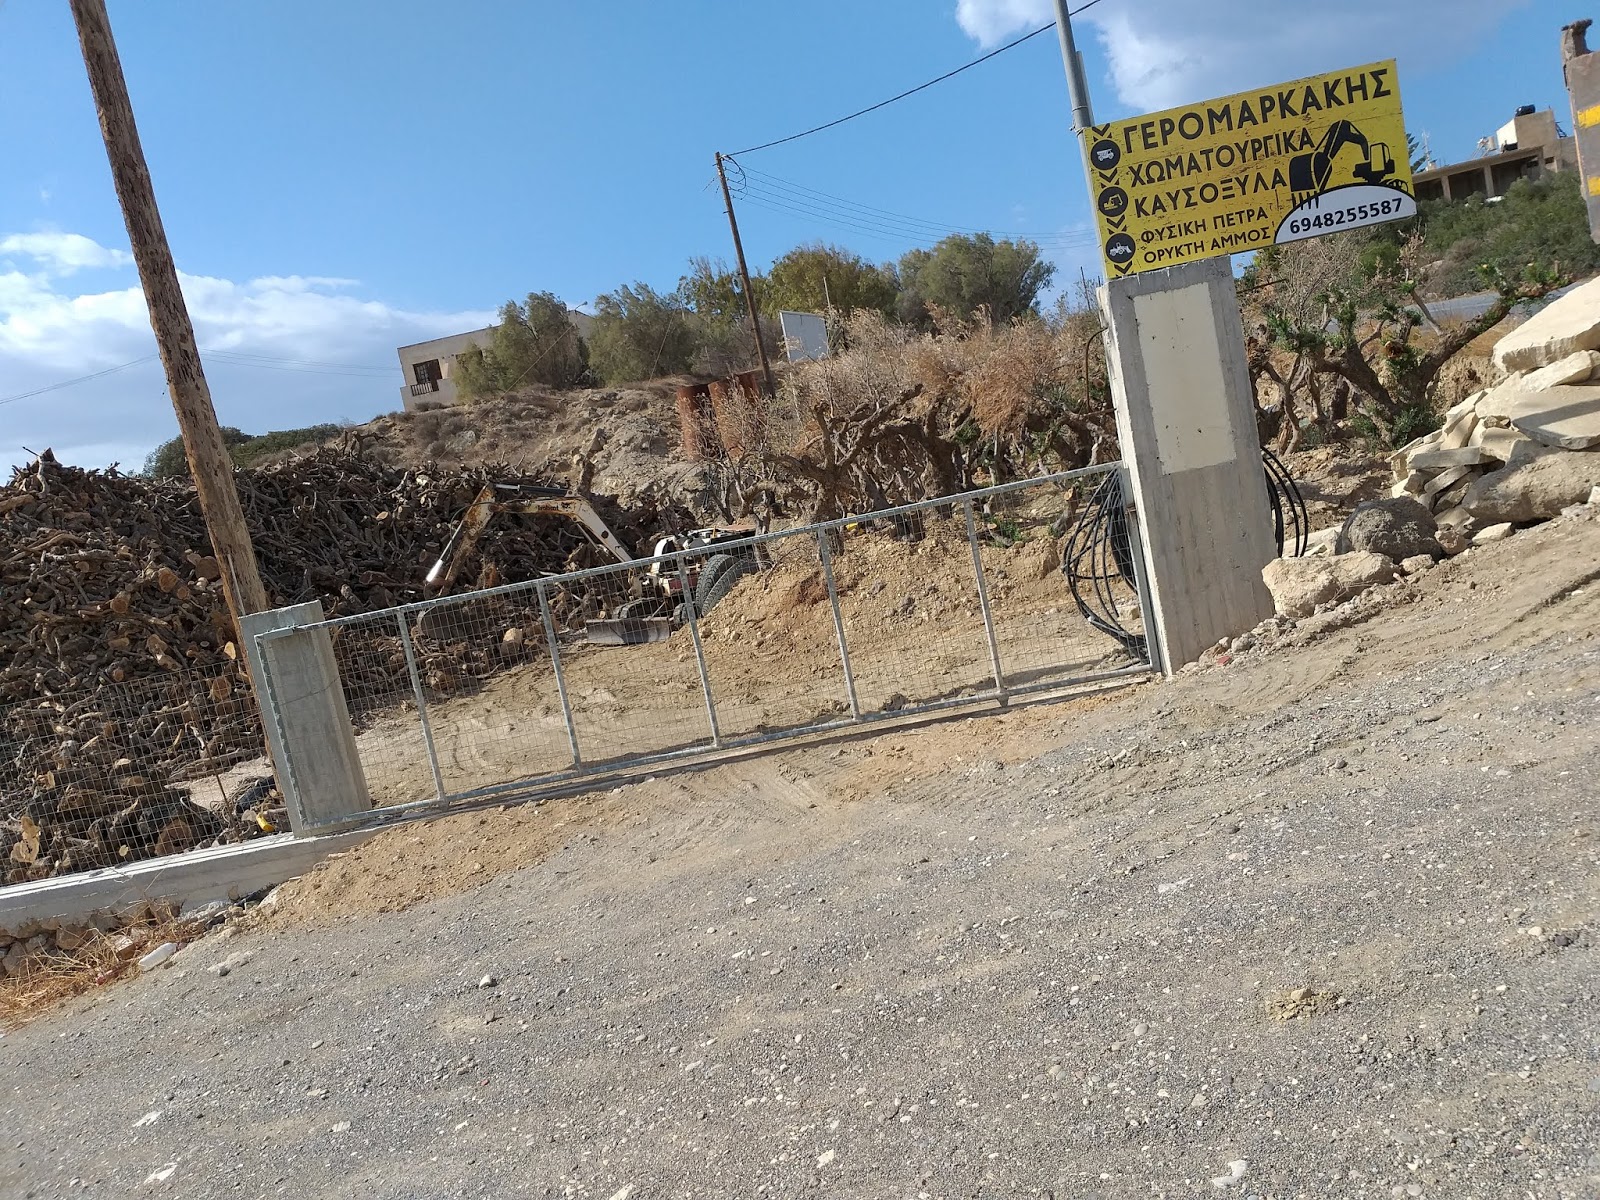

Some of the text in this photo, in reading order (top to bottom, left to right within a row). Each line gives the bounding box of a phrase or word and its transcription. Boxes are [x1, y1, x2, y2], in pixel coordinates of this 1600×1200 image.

[1124, 69, 1391, 153] ΓΕΡΟΜΑΡΚΑΚΗΣ
[1129, 127, 1315, 187] ΧΩΜΑΤΟΥΡΓΙΚΑ
[1134, 168, 1287, 218] ΚΑΥΣΟΞΥΛΑ
[1141, 207, 1268, 243] ΦΥΣΙΚΗ ΠΕΤΡΑ
[1290, 198, 1402, 234] 6948255587
[1144, 227, 1271, 263] ΟΡΥΚΤΗ ΑΜΜΟΣ
